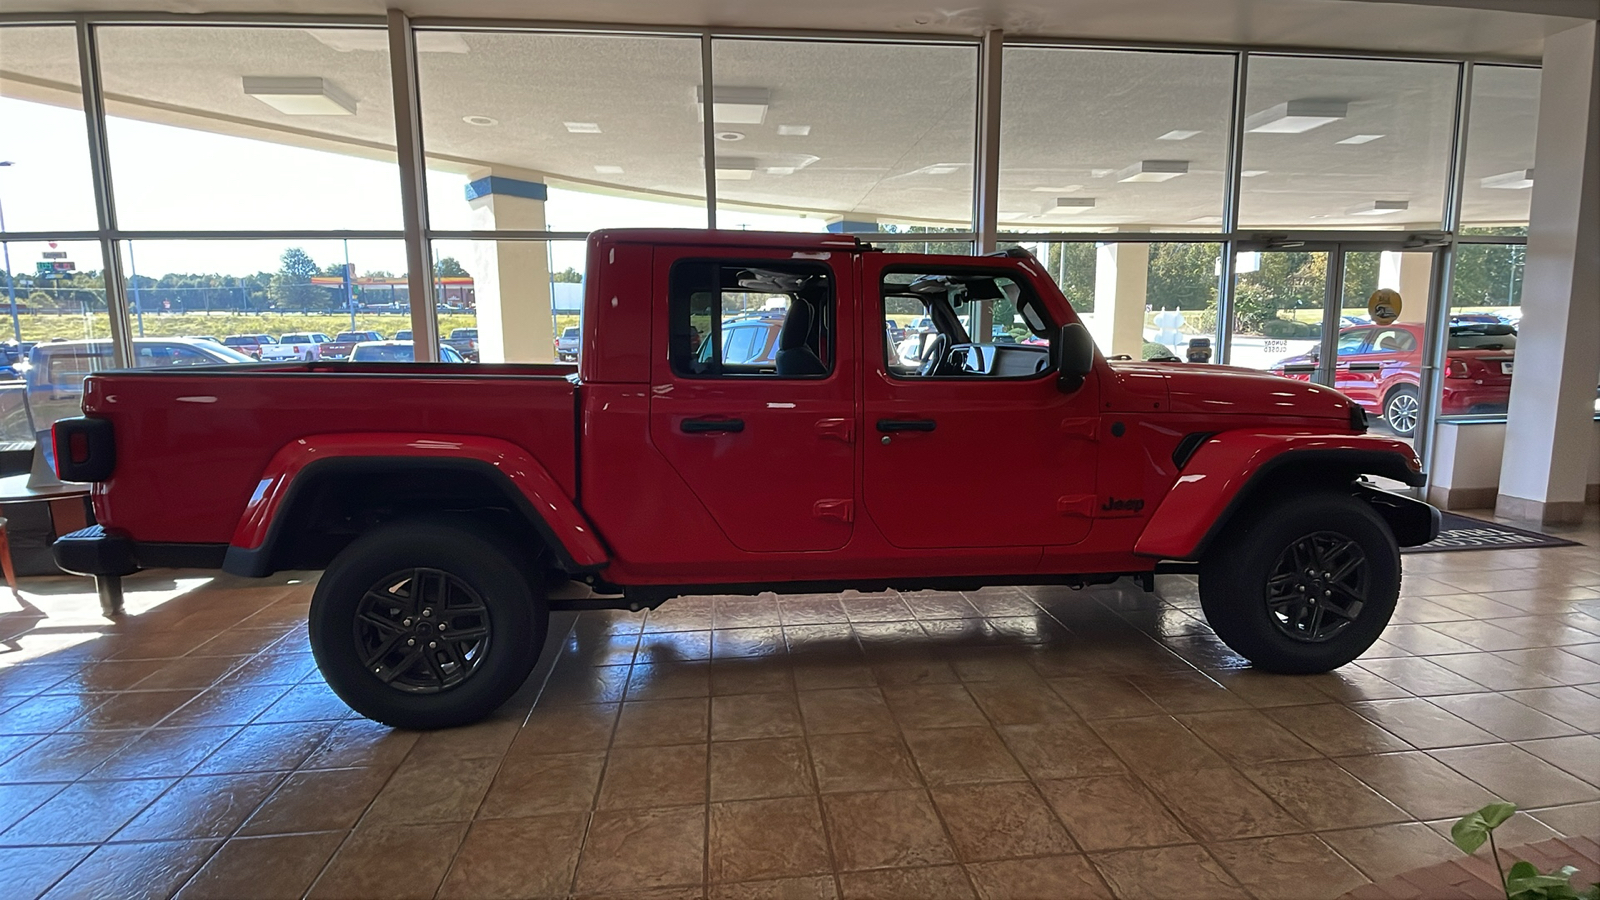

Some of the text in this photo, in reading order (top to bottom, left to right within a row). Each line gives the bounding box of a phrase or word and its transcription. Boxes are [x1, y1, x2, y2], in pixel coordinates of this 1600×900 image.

[1101, 496, 1145, 513] Jeep
[1437, 528, 1516, 538] TRUC
[1410, 535, 1545, 550] WELCOM
